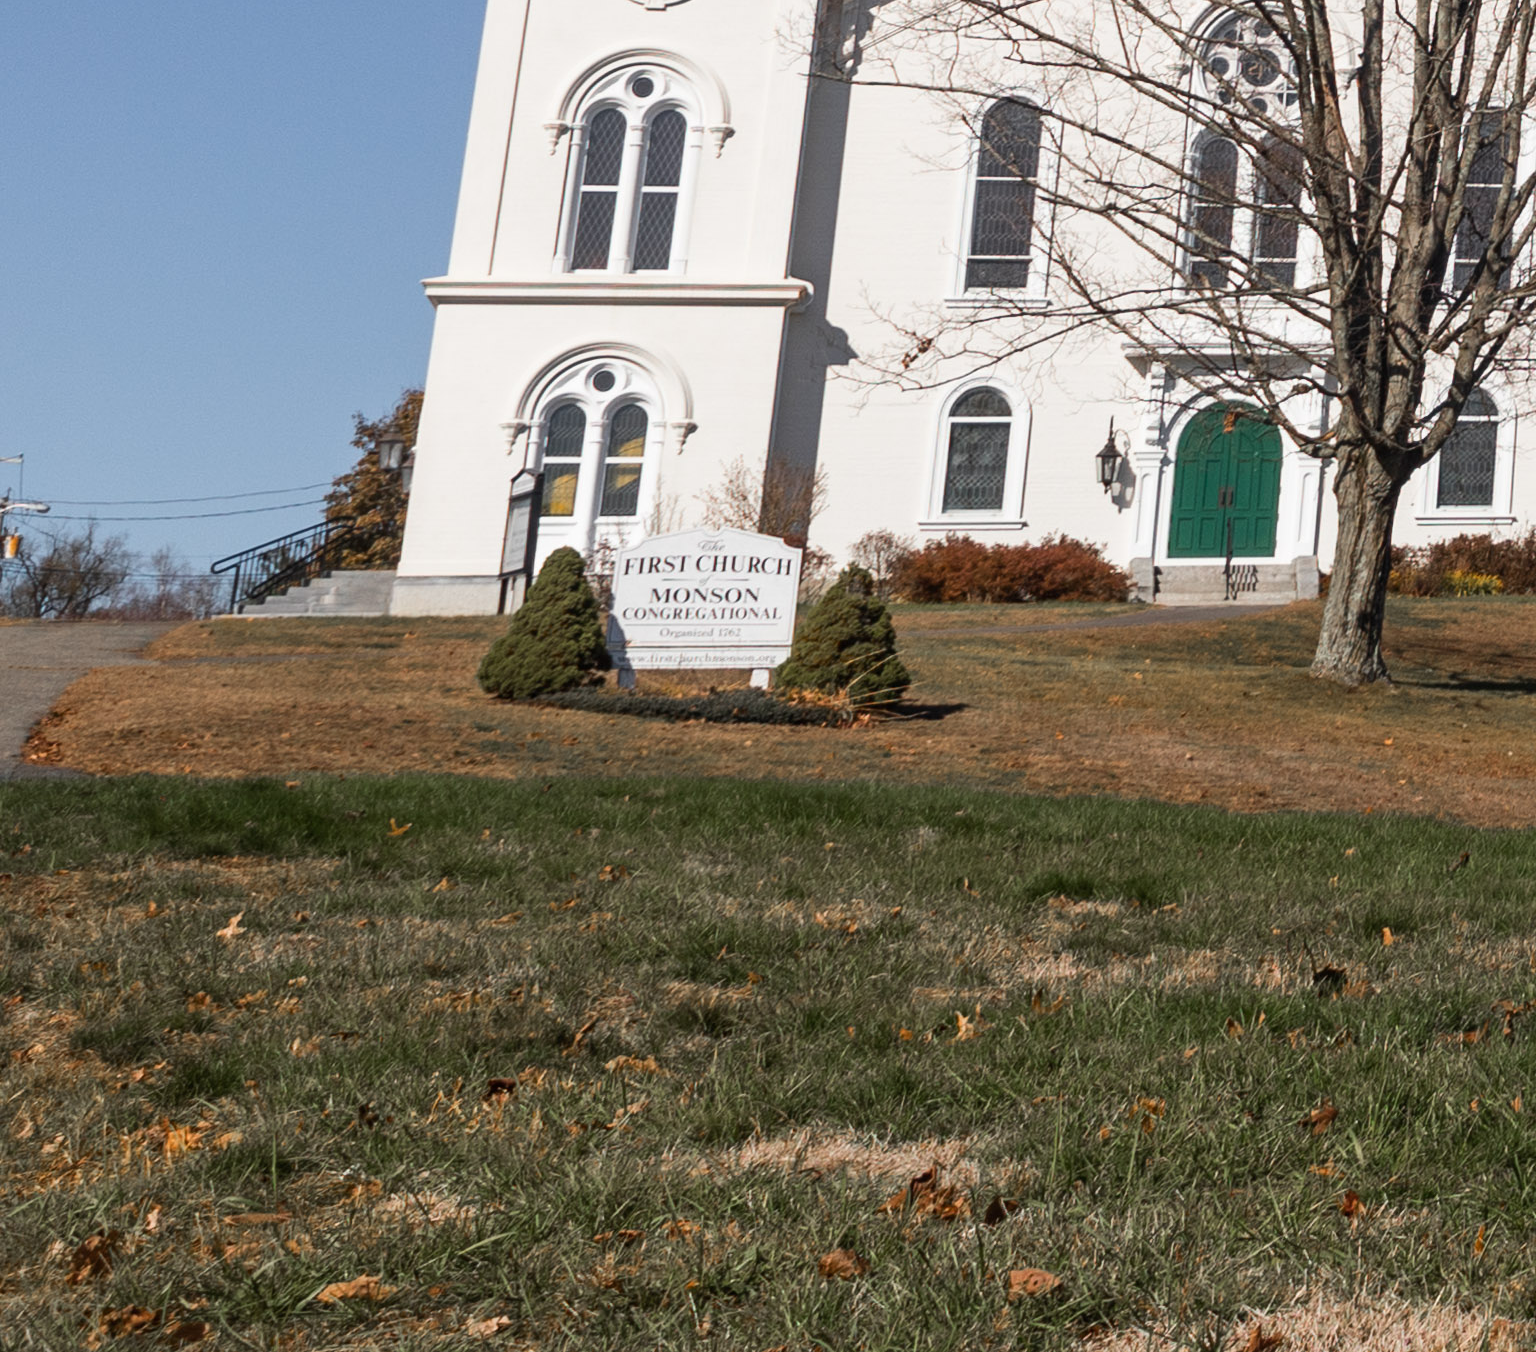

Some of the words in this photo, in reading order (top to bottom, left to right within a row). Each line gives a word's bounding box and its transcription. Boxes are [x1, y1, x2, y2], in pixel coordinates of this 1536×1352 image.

[697, 539, 725, 553] The
[624, 555, 692, 576] FIRST
[695, 554, 793, 576] CHURCH
[650, 587, 761, 604] MONSON
[622, 606, 782, 621] CONGREGATIONAL
[659, 627, 714, 638] Organized
[718, 627, 741, 637] 1762
